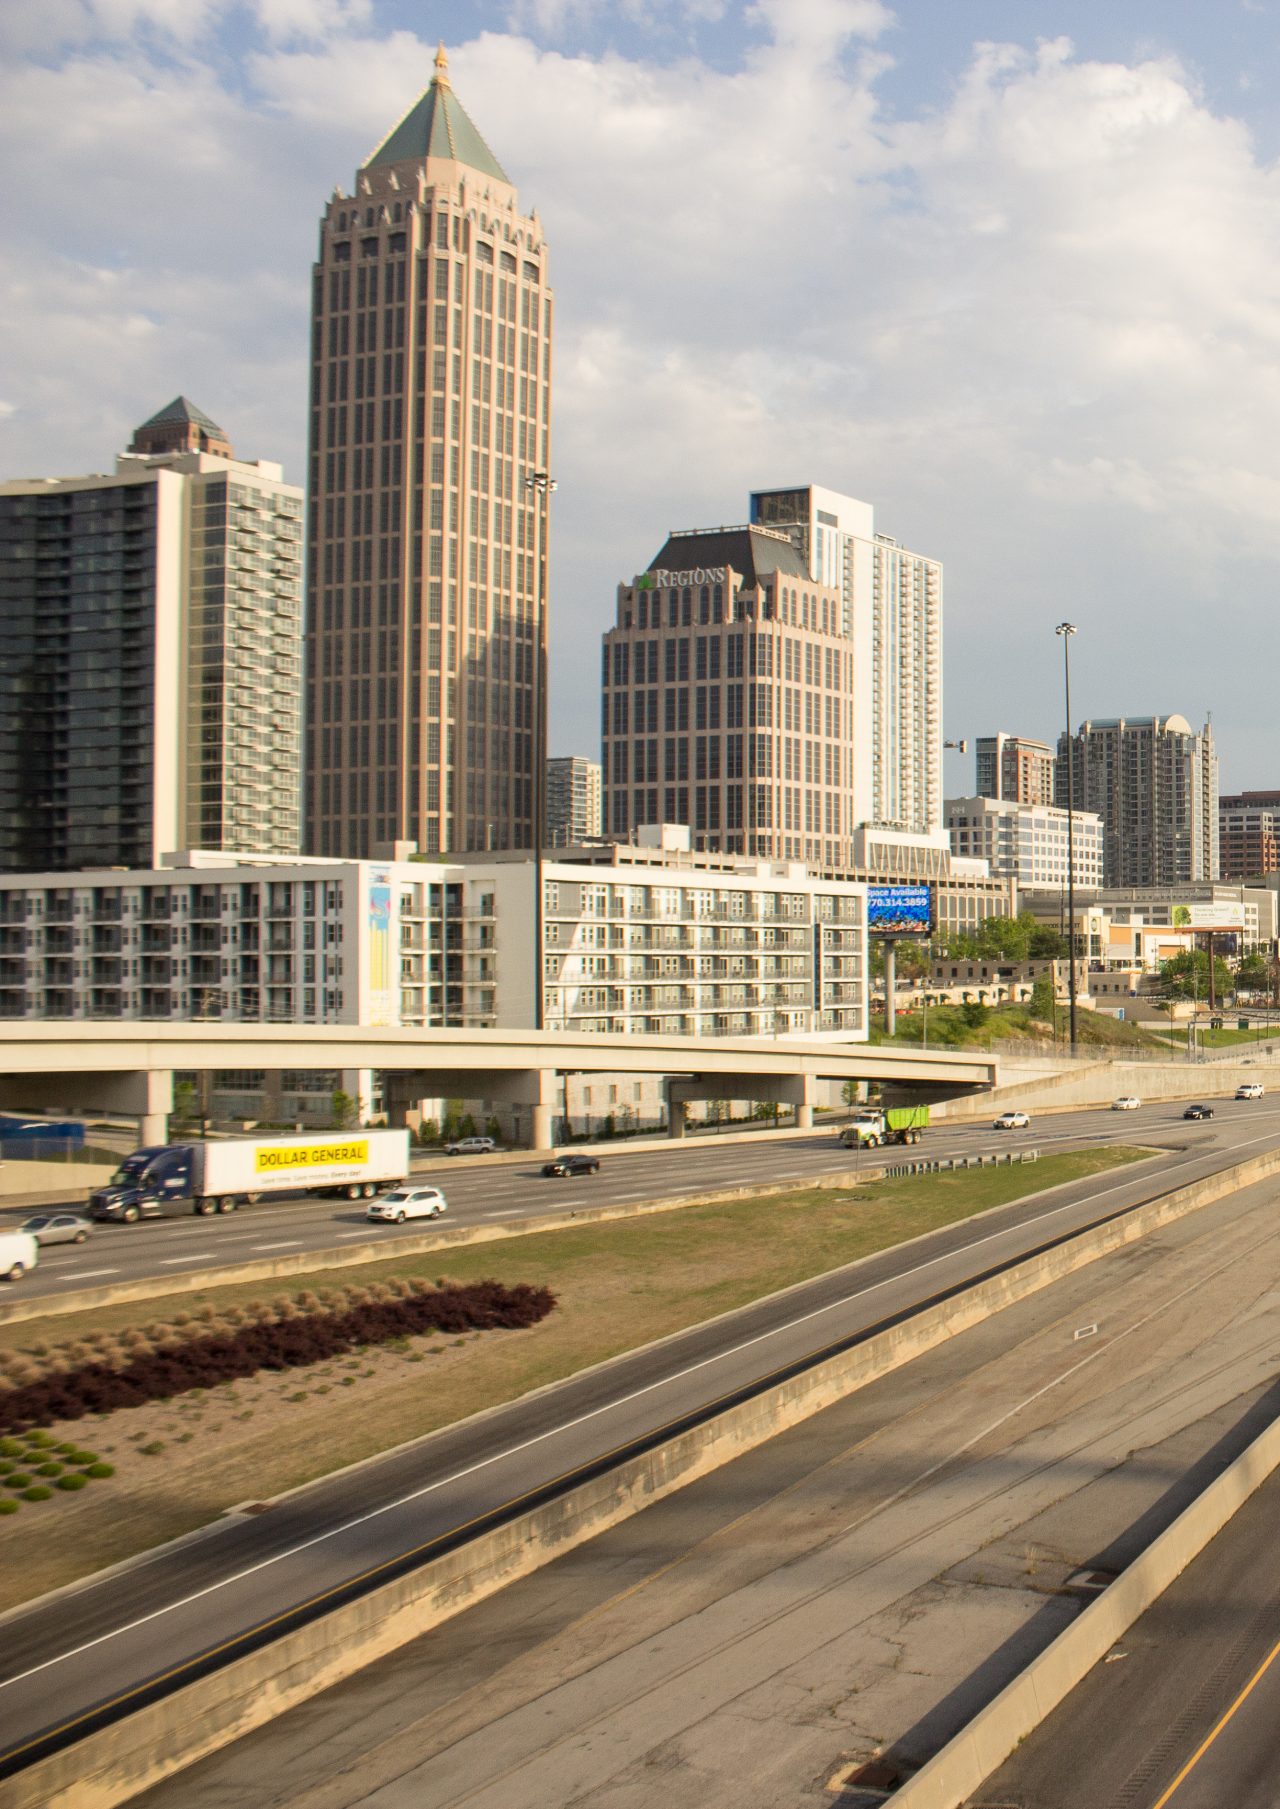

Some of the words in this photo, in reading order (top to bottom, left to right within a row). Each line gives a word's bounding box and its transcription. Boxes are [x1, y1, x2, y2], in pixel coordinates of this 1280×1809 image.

[656, 567, 725, 588] REGIONS
[890, 888, 928, 896] Available
[259, 1151, 308, 1167] DOLLAR
[312, 1147, 364, 1163] GENERAL
